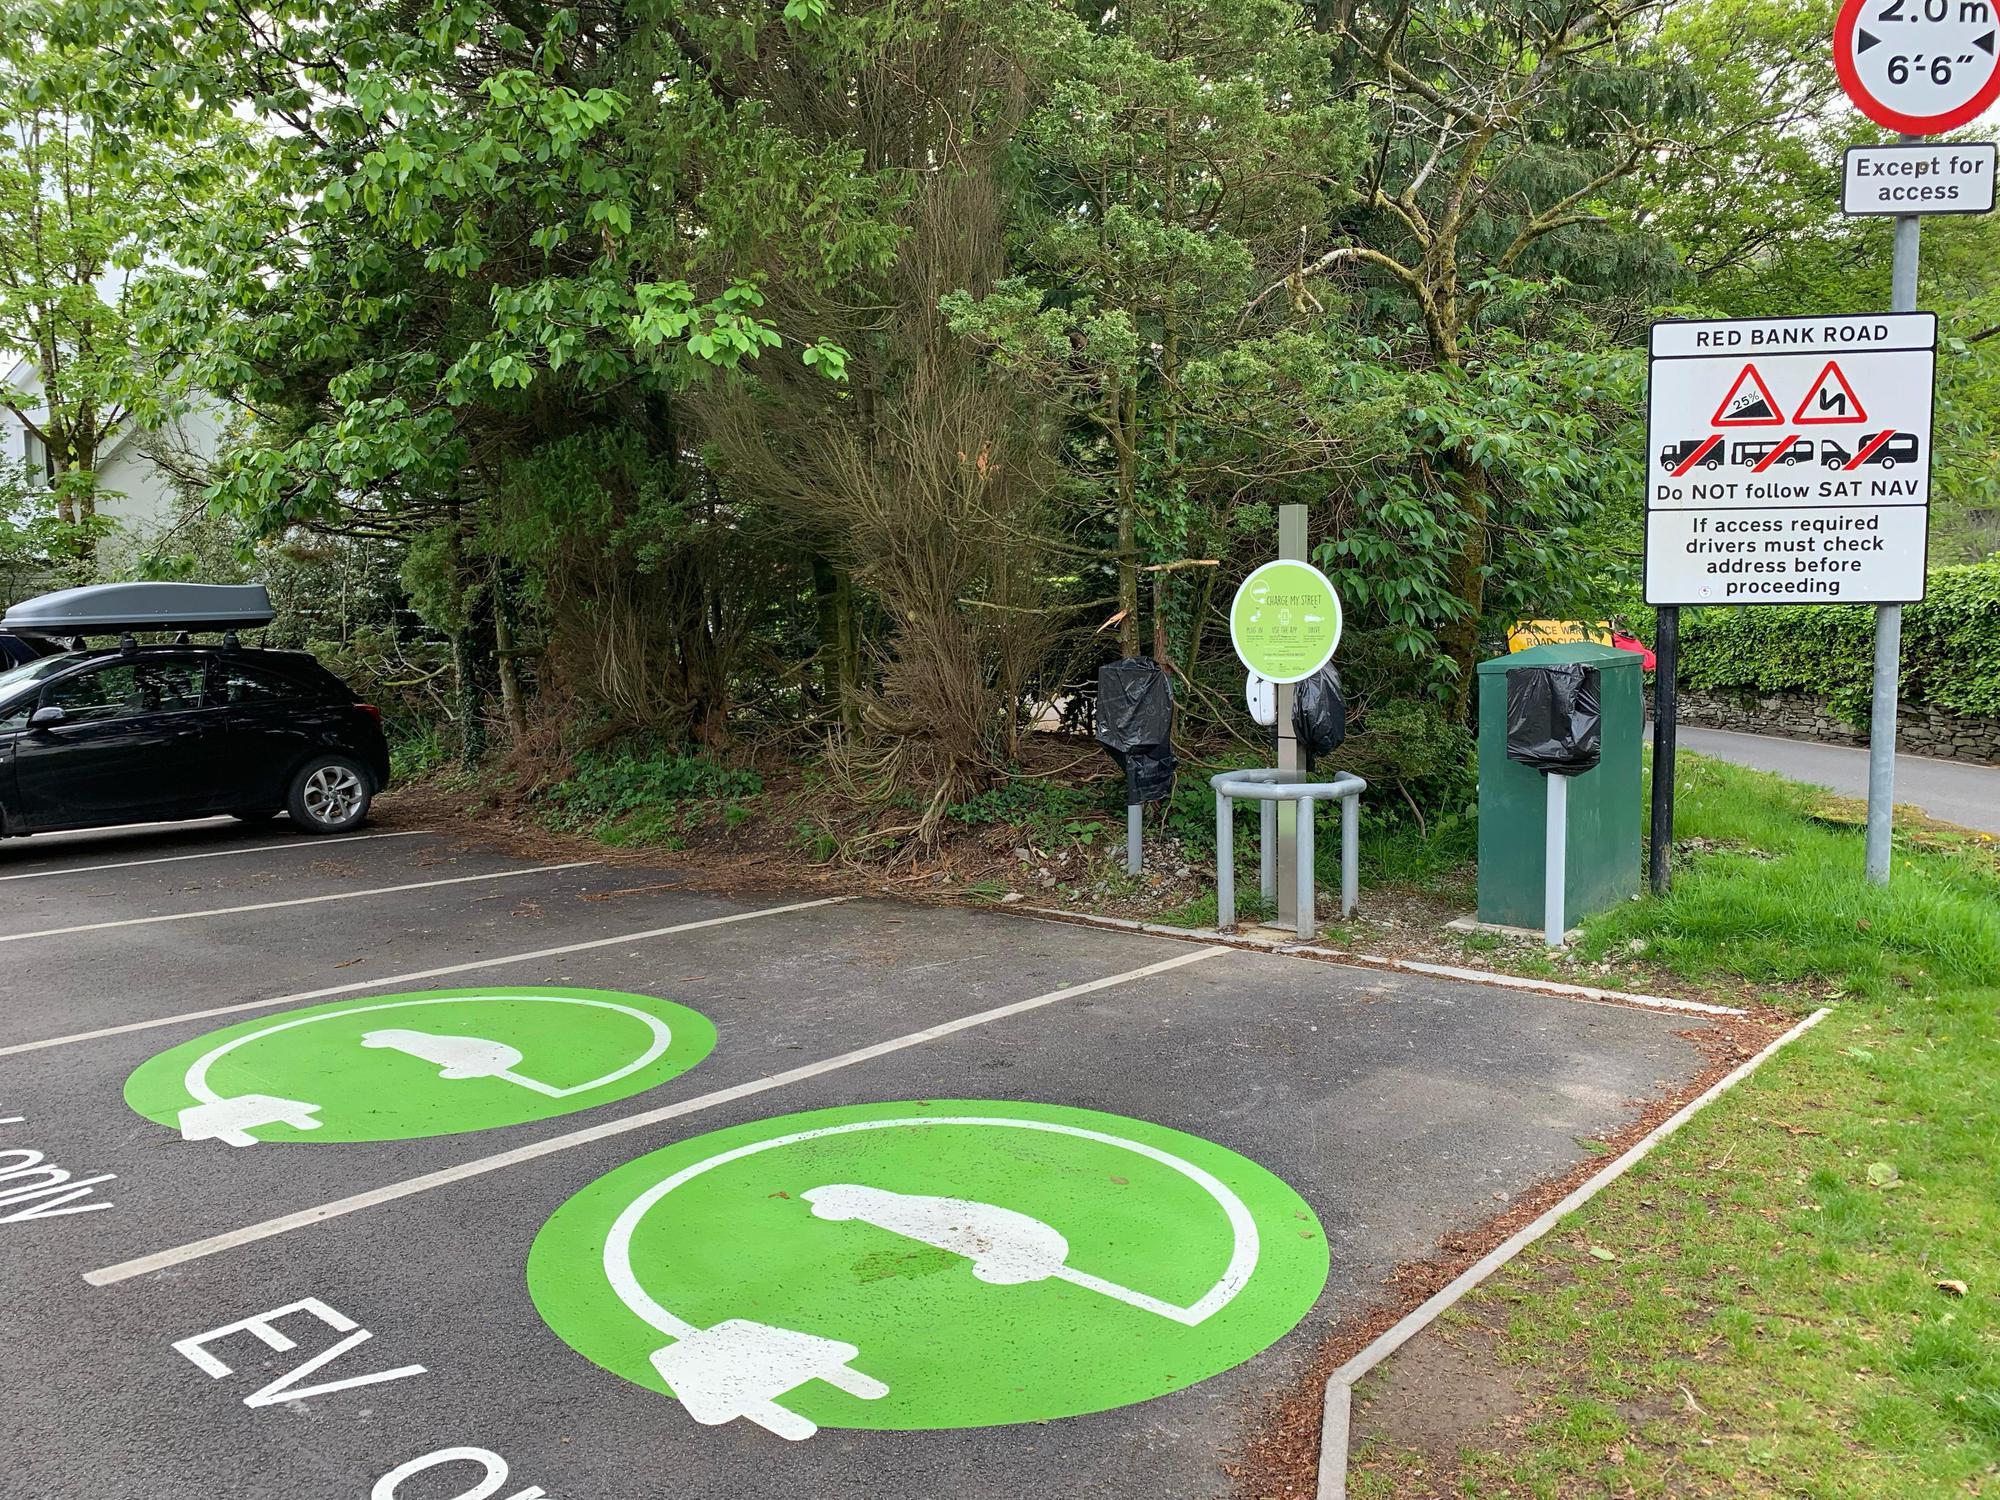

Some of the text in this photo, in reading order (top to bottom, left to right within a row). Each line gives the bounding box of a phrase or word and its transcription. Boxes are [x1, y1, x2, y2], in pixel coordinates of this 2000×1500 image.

[1879, 0, 1988, 22] 2.0 m
[1857, 156, 1983, 178] Except for
[1879, 186, 1958, 200] access
[1697, 326, 1887, 346] RED BANK ROAD
[1733, 390, 1760, 410] 25%
[1658, 480, 1918, 500] Do NOT follow SAT NAV
[1694, 515, 1878, 533] If access required
[1687, 536, 1884, 553] drivers must check
[1707, 557, 1861, 573] address before
[1727, 578, 1839, 596] proceeding
[1266, 594, 1321, 606] CHARGE MY STREET
[172, 1296, 428, 1408] EV
